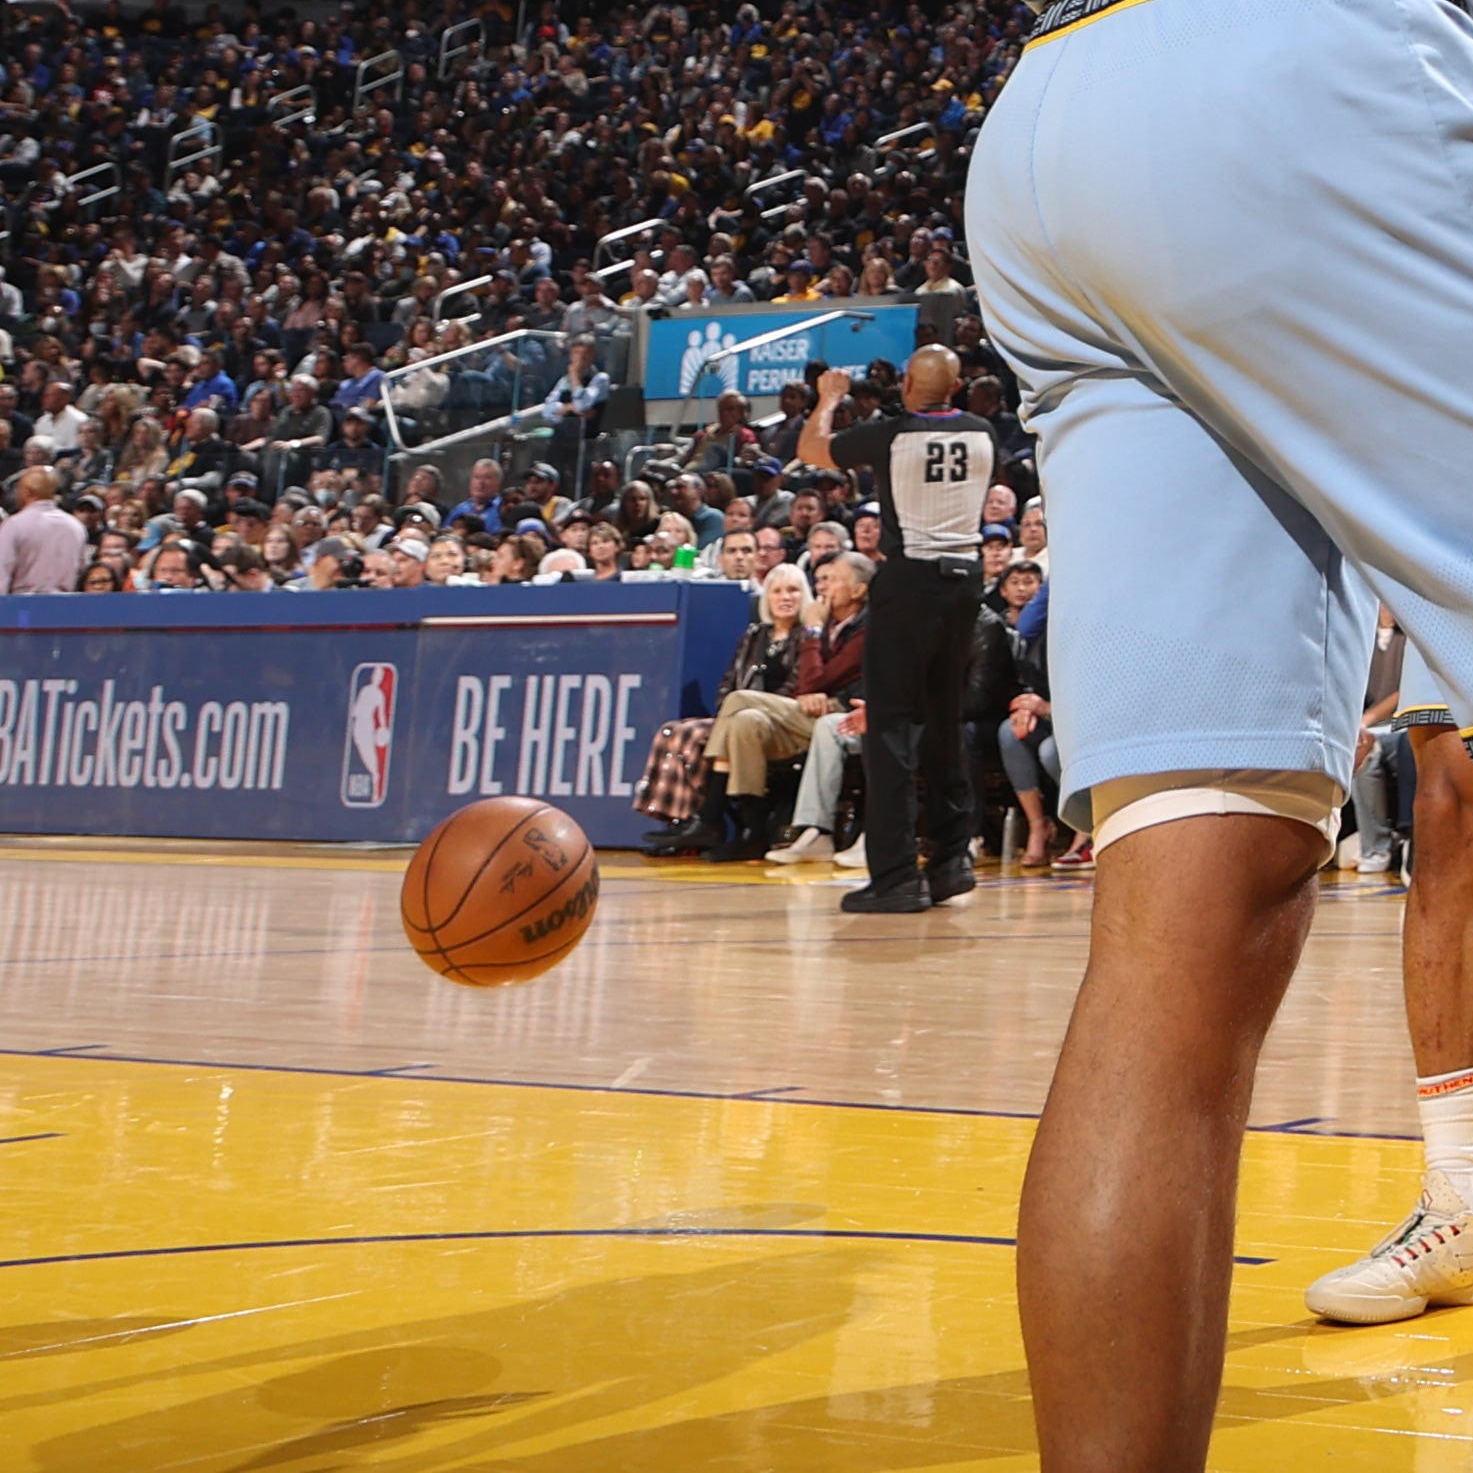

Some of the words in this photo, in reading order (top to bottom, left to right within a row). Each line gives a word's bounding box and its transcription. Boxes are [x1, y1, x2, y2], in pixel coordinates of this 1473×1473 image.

[924, 441, 968, 484] 23
[447, 674, 512, 796] BE
[516, 673, 644, 798] HERE
